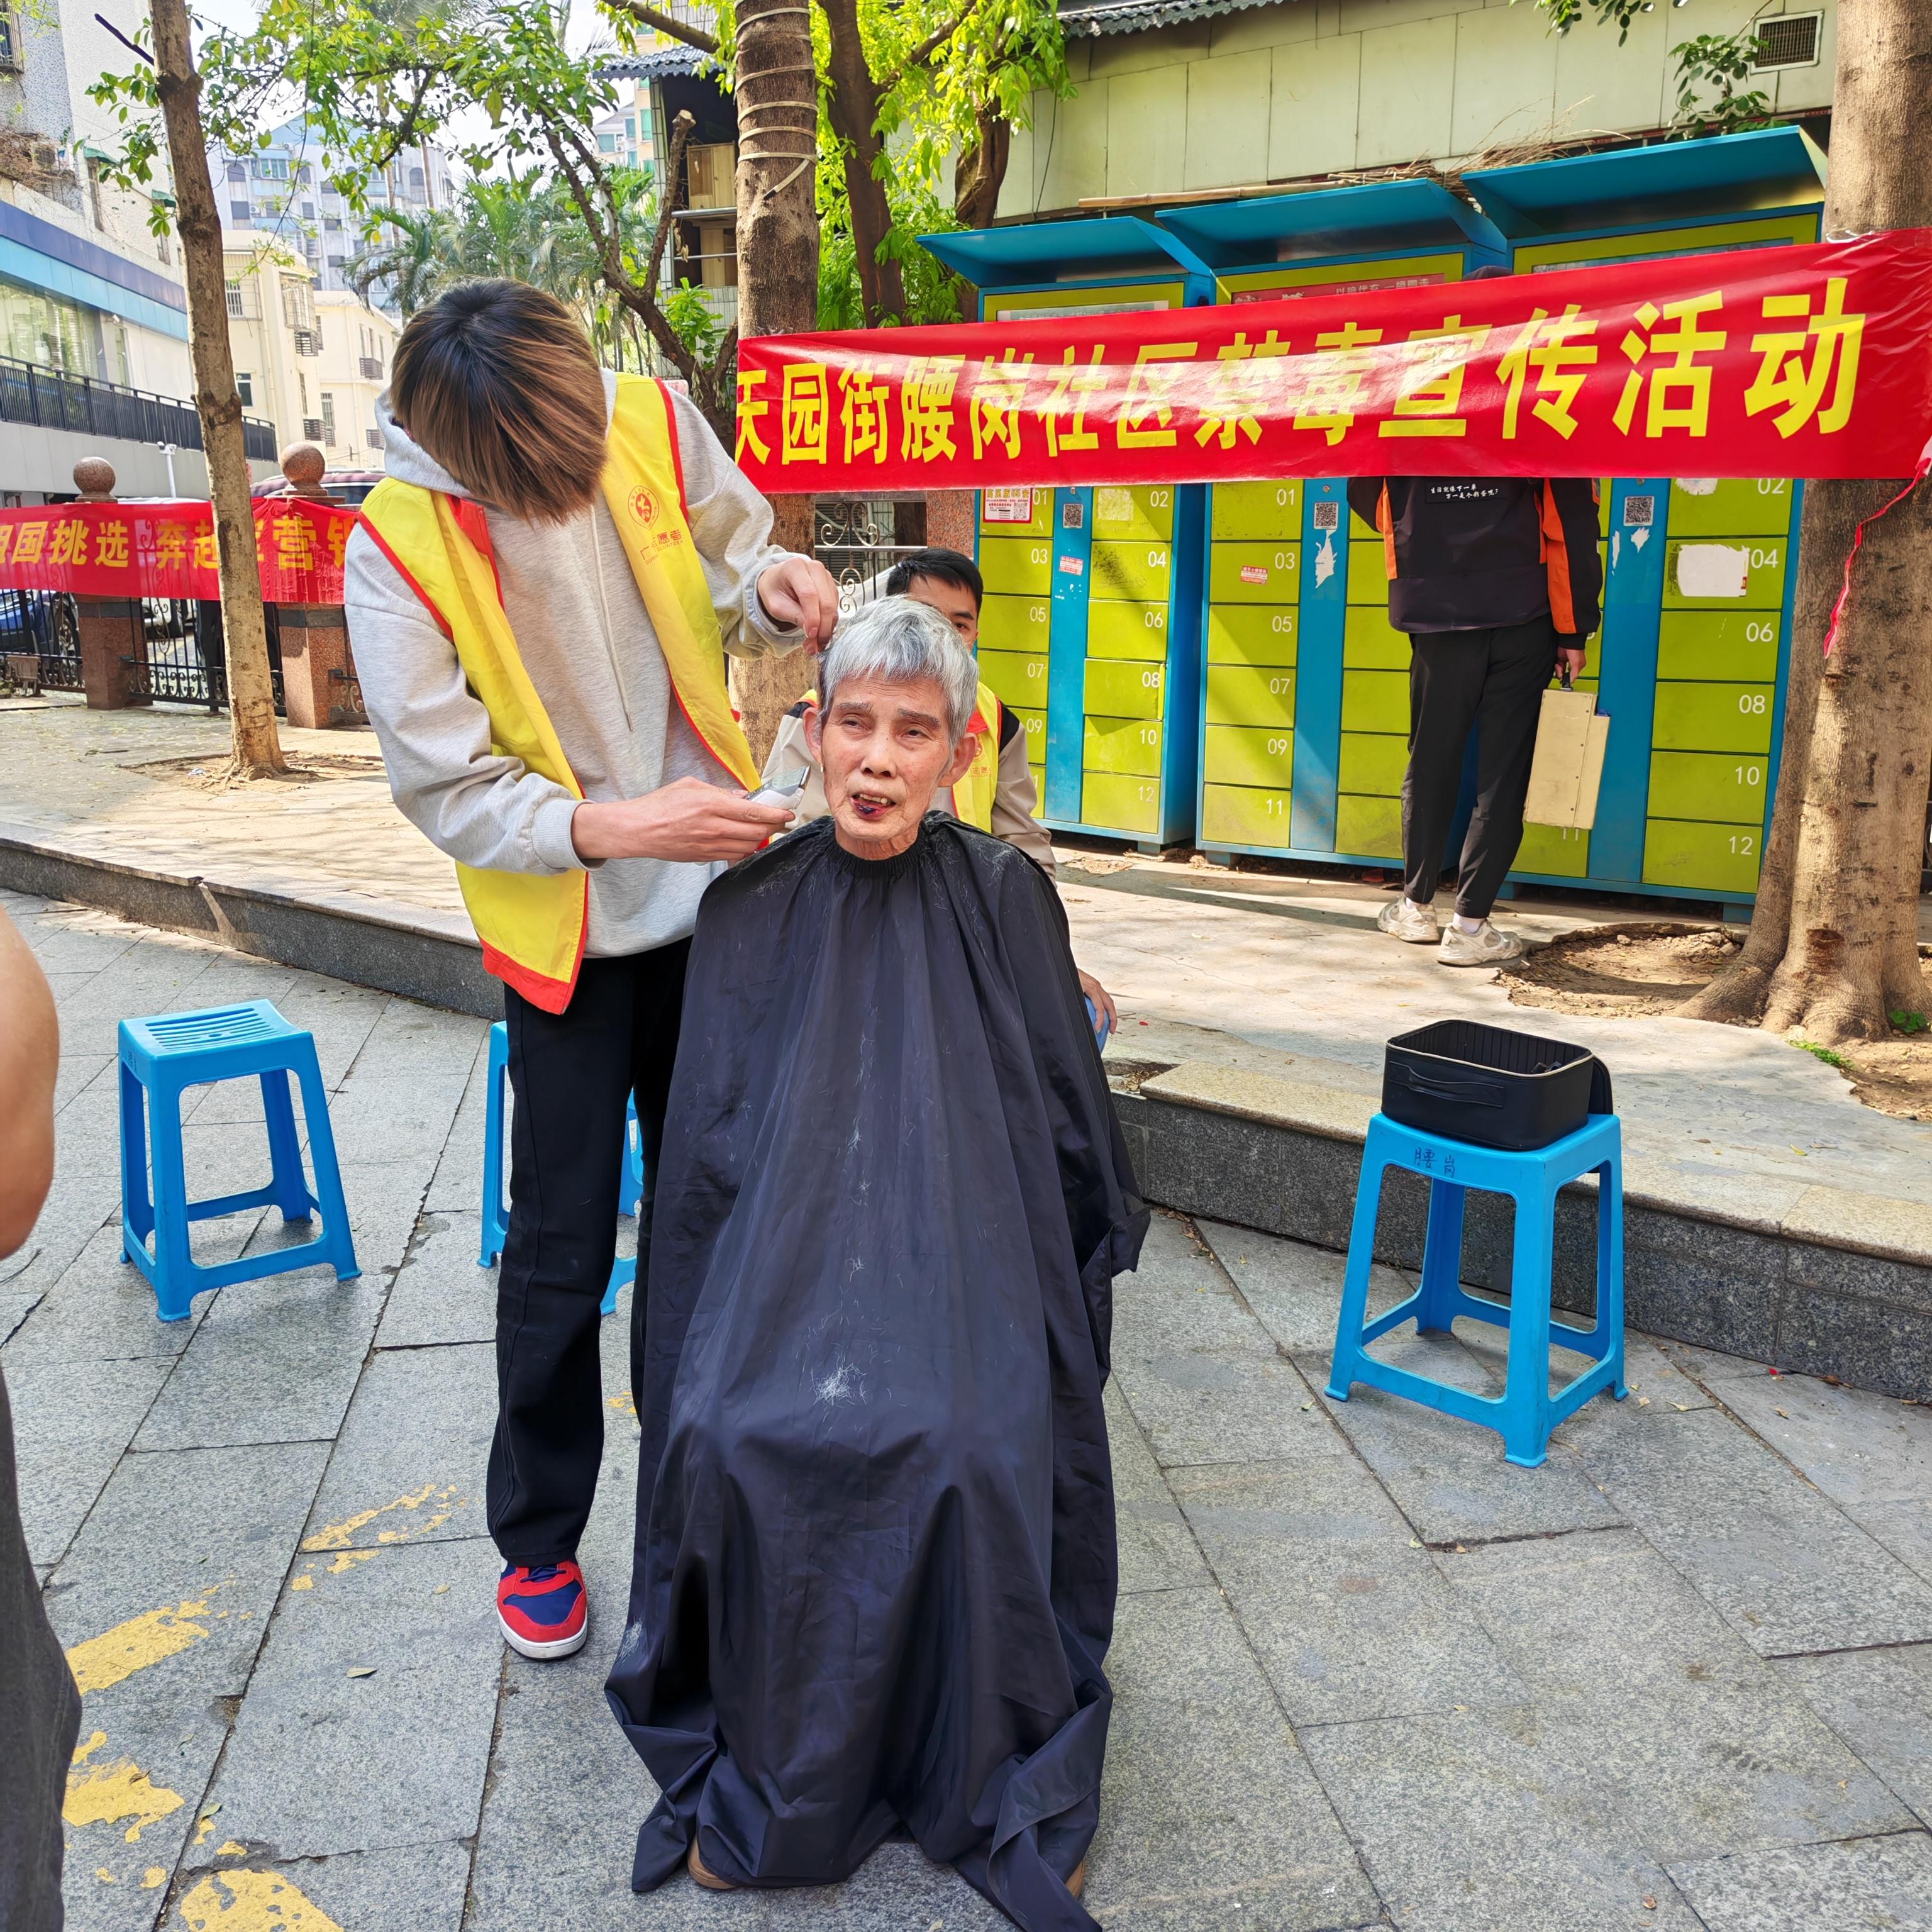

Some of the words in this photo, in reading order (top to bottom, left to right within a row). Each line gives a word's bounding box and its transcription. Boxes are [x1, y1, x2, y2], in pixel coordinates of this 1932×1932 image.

[735, 277, 1866, 465] 天园街腰岗社区禁毒宣传活动
[1758, 479, 1785, 495] 02
[1033, 489, 1047, 505] 01
[1150, 491, 1168, 508] 02
[1277, 489, 1295, 506] 01
[1031, 548, 1048, 564] 03
[1148, 551, 1167, 567] 04
[1275, 552, 1296, 570] 03
[1750, 548, 1779, 569] 04
[1030, 606, 1046, 623] 05
[1145, 611, 1163, 628] 06
[1272, 615, 1292, 633] 05
[1746, 623, 1774, 643] 06
[1027, 662, 1044, 678] 07
[1142, 672, 1161, 688] 08
[1270, 677, 1291, 695] 07
[1739, 694, 1765, 714] 08
[1026, 718, 1043, 734] 09
[1140, 729, 1157, 745] 10
[1267, 738, 1288, 755] 09
[1735, 766, 1760, 786] 10
[1138, 786, 1155, 802] 12
[1266, 799, 1284, 816] 11
[1728, 835, 1753, 856] 12
